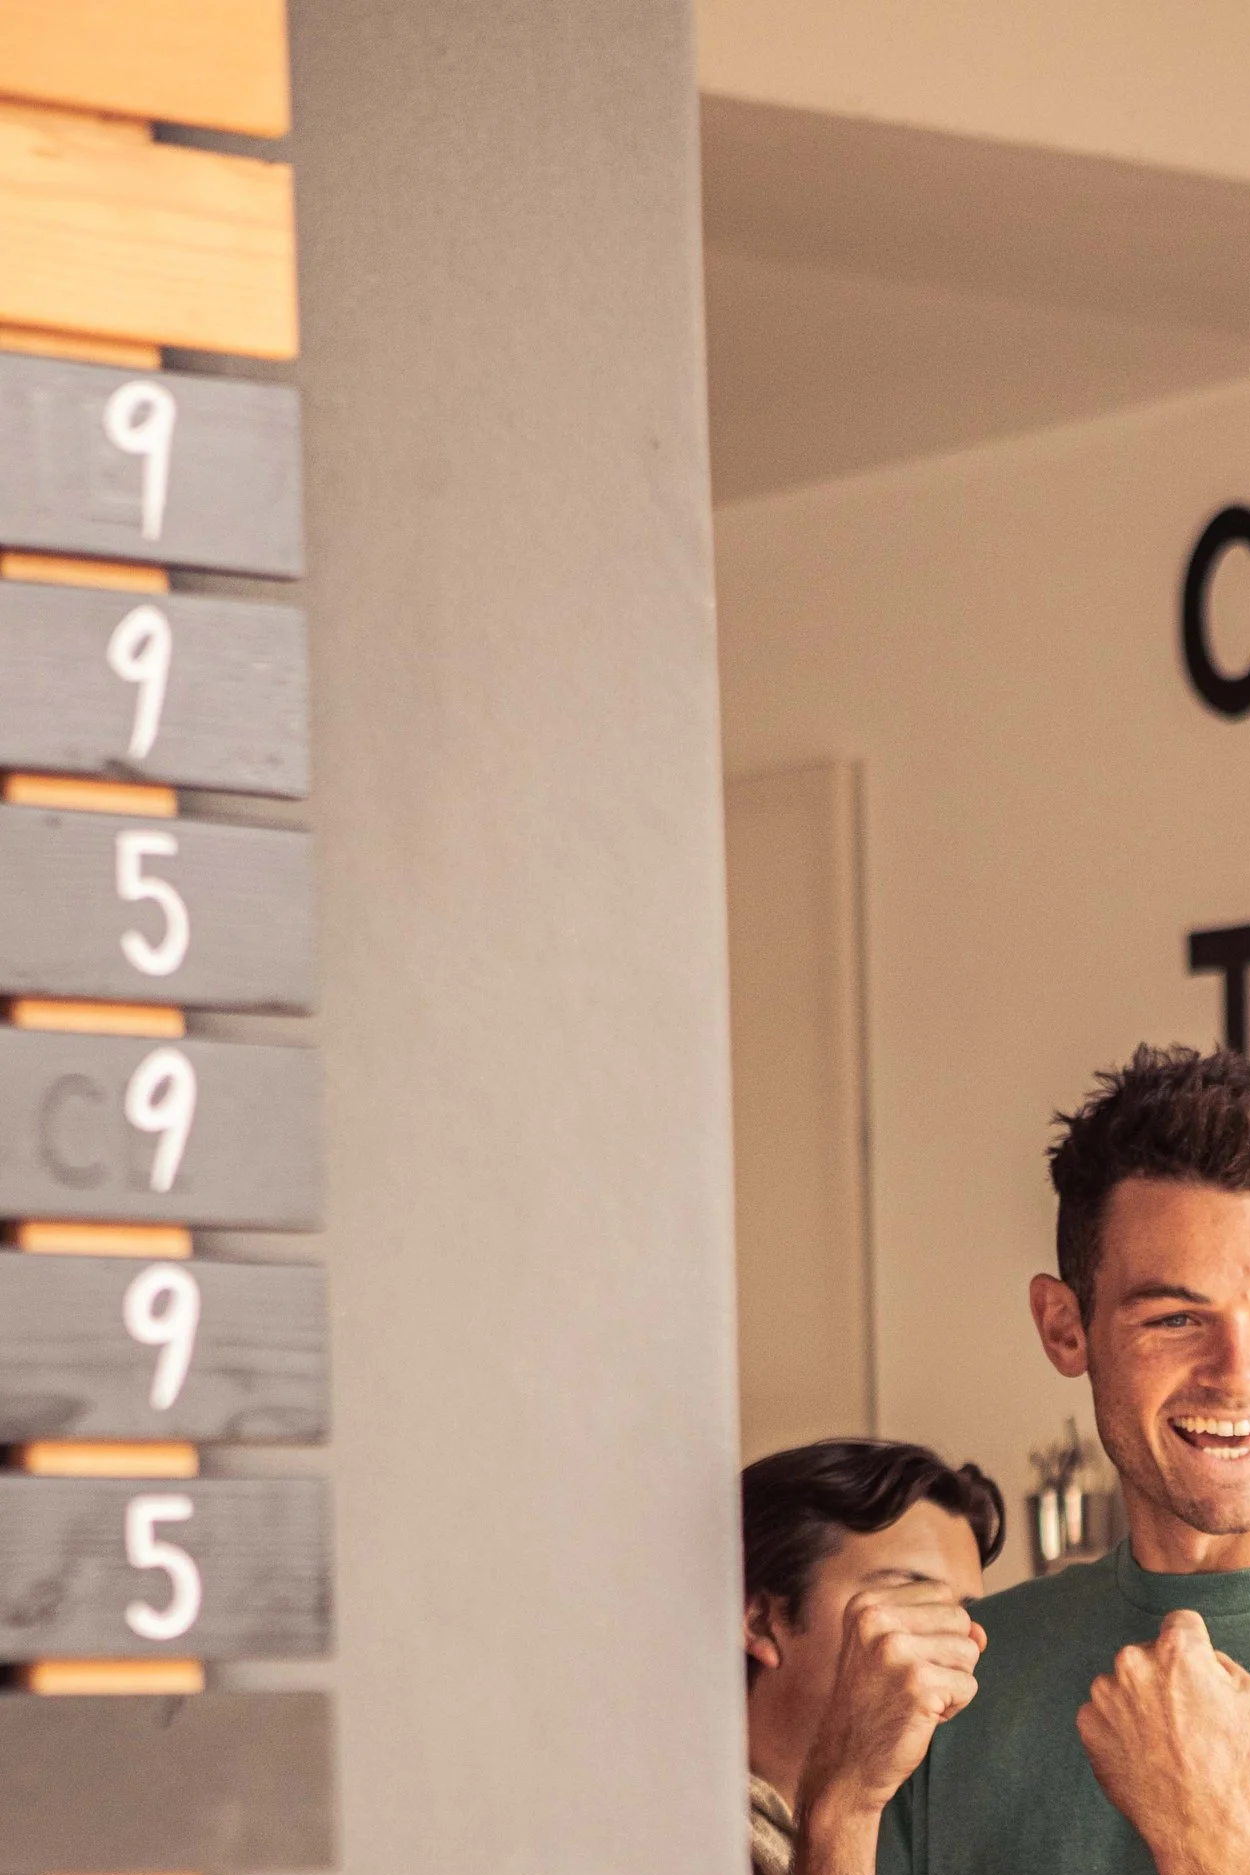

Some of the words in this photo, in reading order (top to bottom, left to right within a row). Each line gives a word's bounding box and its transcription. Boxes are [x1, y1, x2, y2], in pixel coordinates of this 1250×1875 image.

[102, 379, 177, 541] 9
[107, 604, 172, 759] 9
[115, 829, 190, 977] 5
[125, 1047, 198, 1192] 9
[124, 1263, 201, 1410] 9
[126, 1495, 201, 1640] 5
